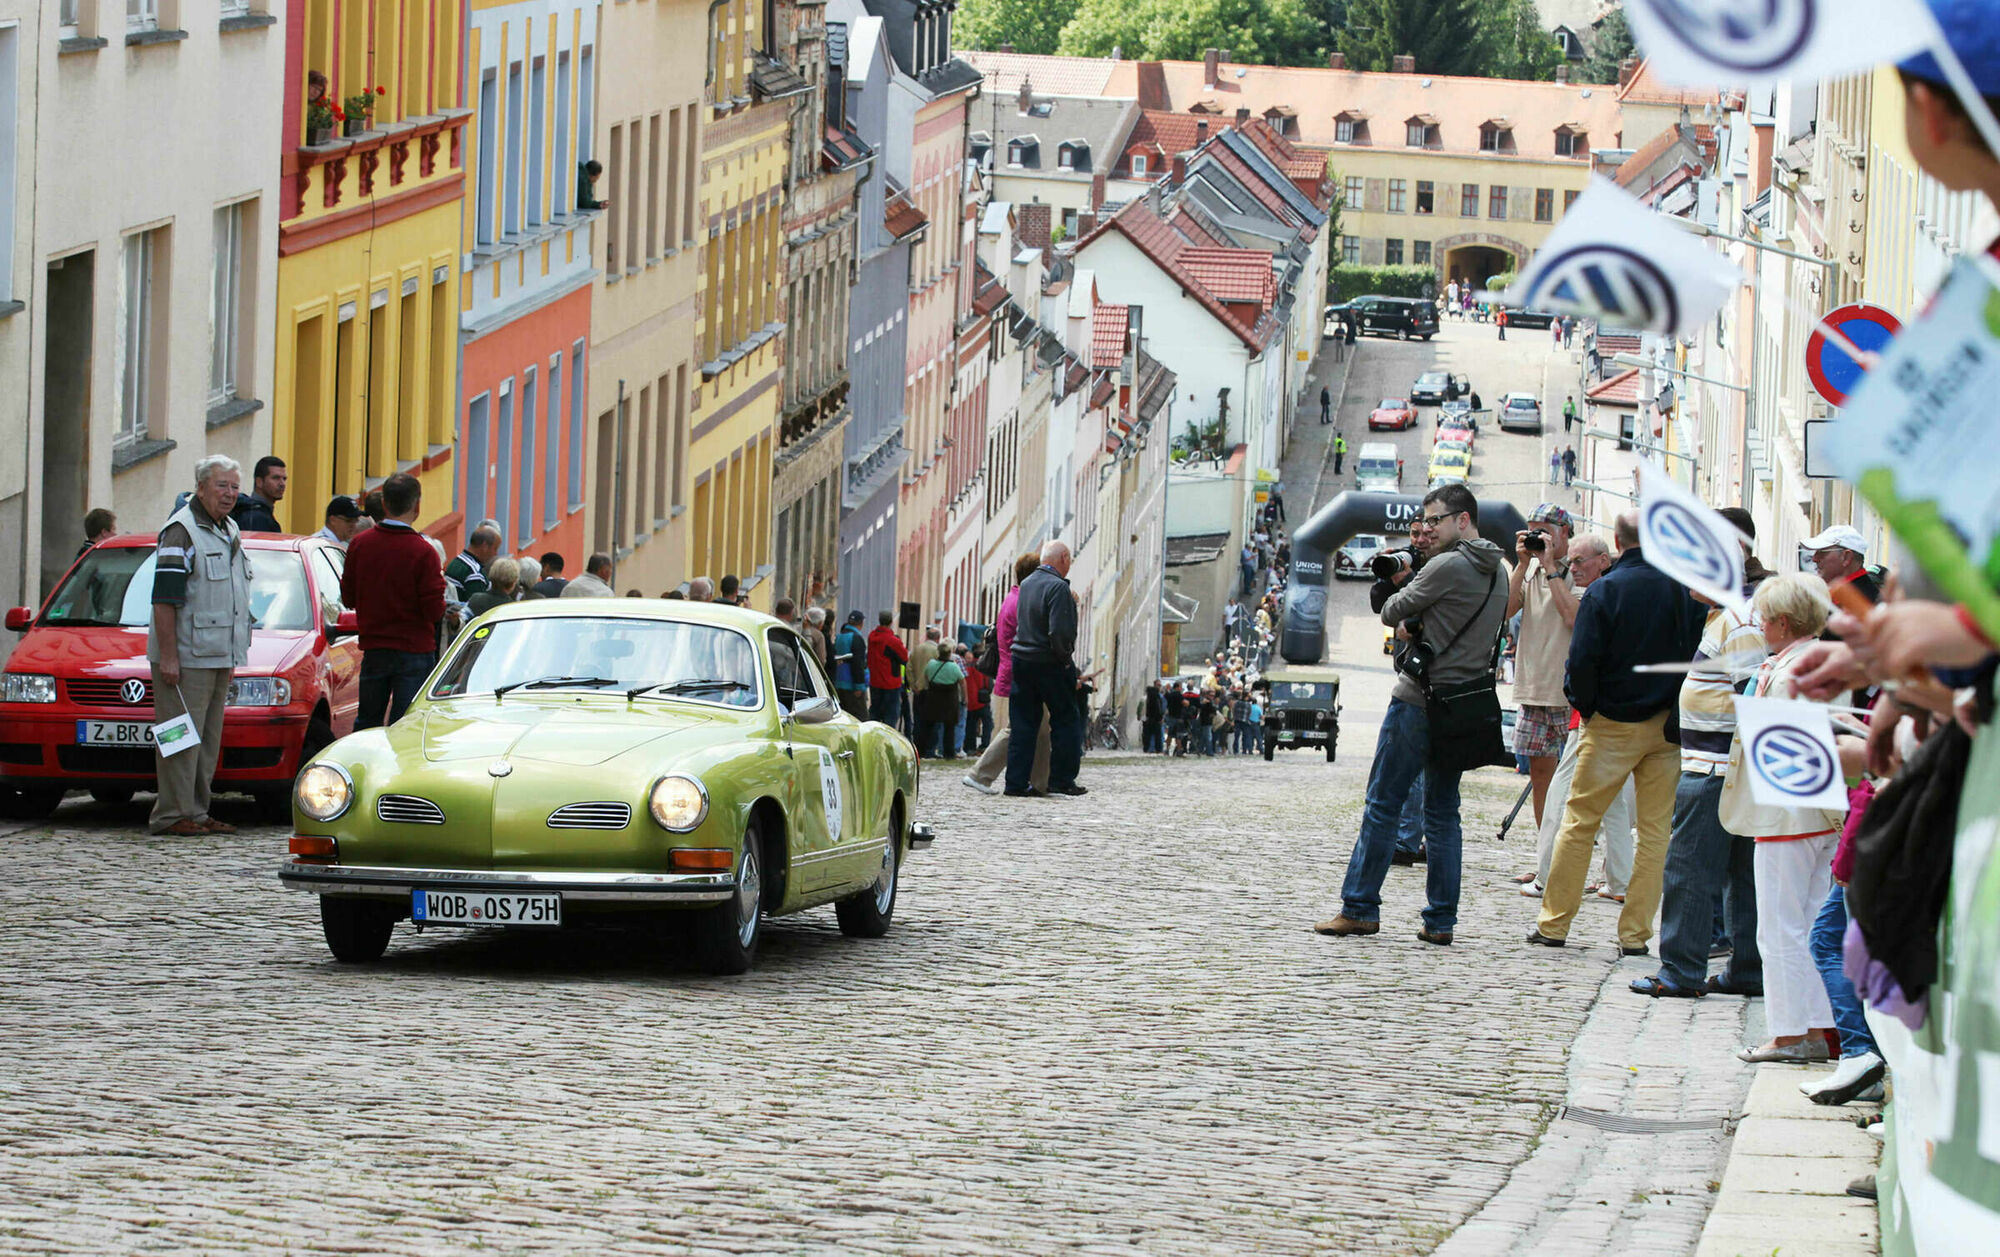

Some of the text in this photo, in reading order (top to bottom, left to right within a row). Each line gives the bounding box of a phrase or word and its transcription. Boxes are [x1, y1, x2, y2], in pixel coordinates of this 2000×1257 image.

[1385, 503, 1420, 520] UN
[1384, 521, 1410, 532] GLAS
[1295, 560, 1323, 570] UNION
[94, 724, 105, 741] Z
[117, 725, 139, 742] BR
[144, 725, 155, 742] 6
[826, 778, 838, 810] 33
[427, 895, 468, 919] WOB
[484, 897, 512, 920] OS
[516, 898, 559, 921] 75H
